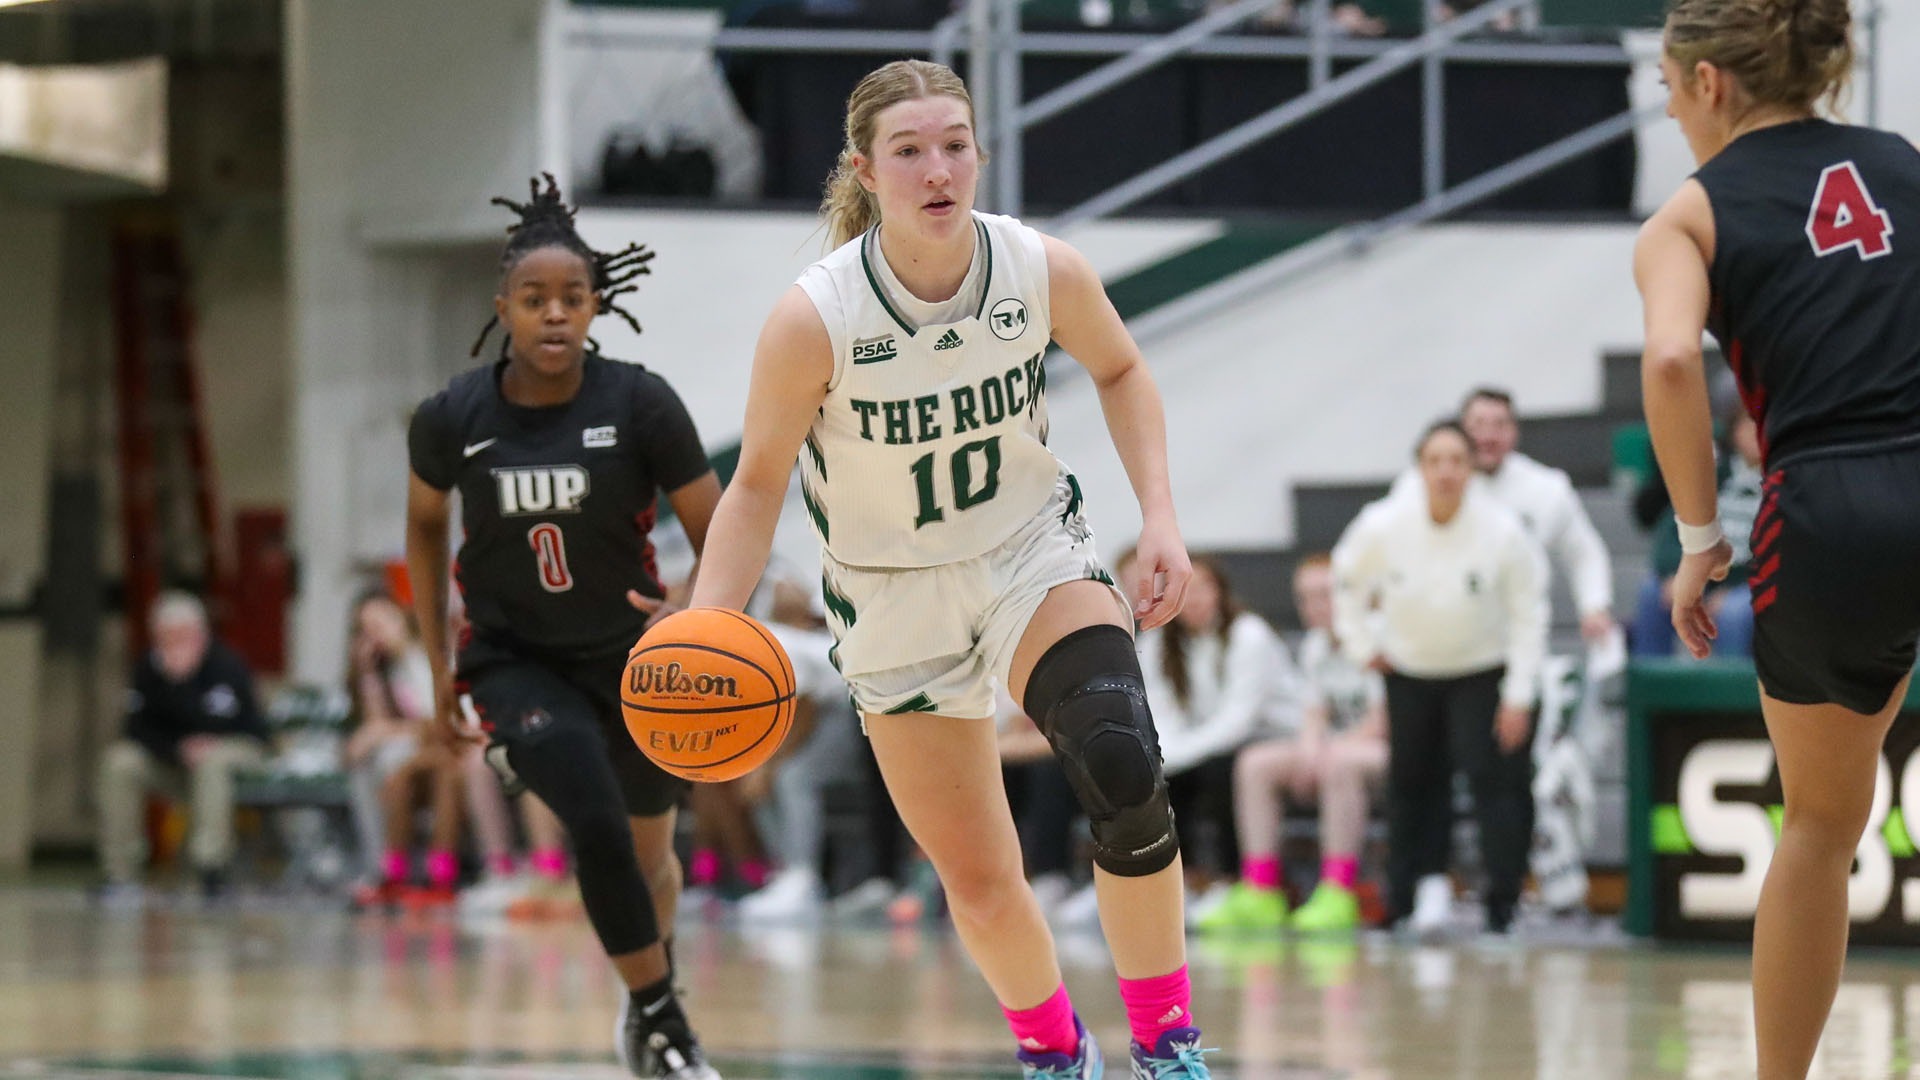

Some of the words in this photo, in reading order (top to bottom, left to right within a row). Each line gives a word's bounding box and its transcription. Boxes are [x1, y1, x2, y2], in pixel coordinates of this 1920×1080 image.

[1804, 160, 1894, 261] 4
[852, 339, 897, 359] PSAC
[934, 339, 964, 351] adidas
[850, 393, 942, 445] THE
[491, 464, 590, 517] IUP
[910, 435, 1002, 531] 10
[528, 523, 573, 593] 0
[629, 661, 738, 699] Wilson
[650, 729, 715, 753] EVO
[715, 723, 739, 738] NXT
